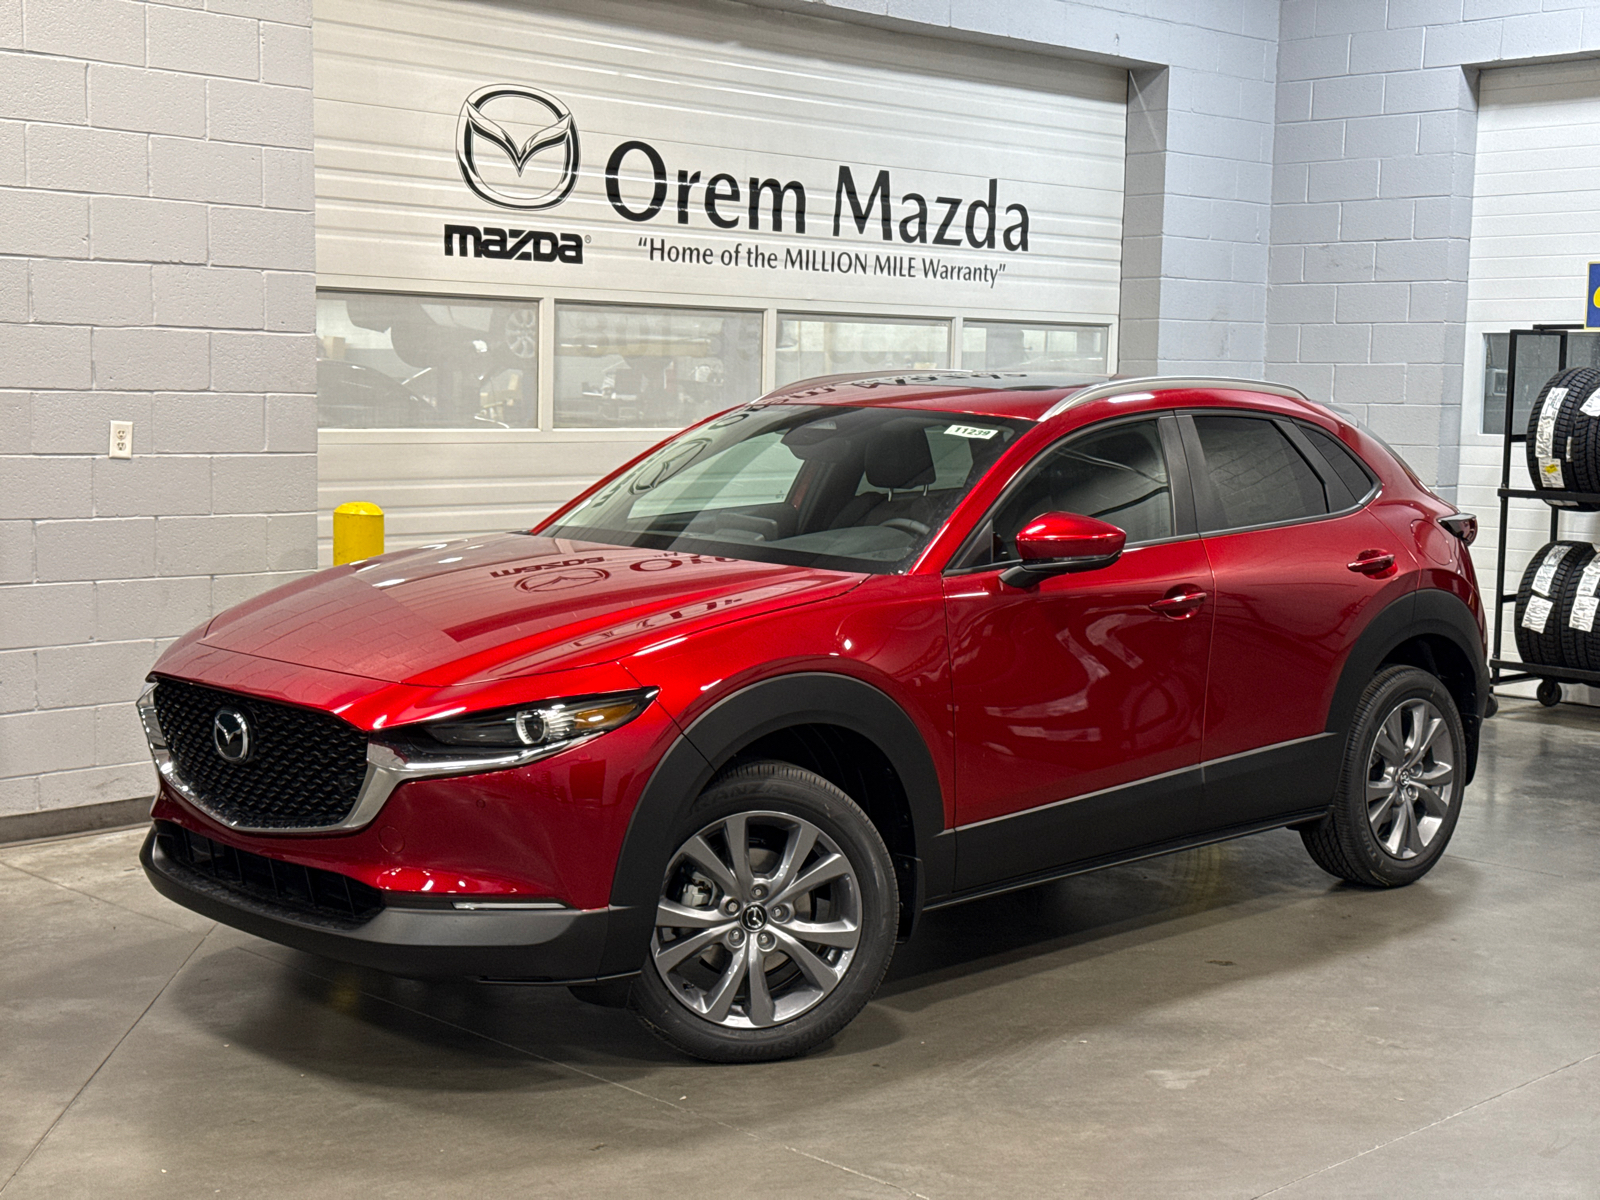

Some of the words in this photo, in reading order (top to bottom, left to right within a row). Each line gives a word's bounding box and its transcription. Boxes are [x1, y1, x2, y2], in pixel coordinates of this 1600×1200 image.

[605, 140, 806, 234] Orem
[832, 165, 1030, 252] Mazda
[720, 243, 742, 267] of
[747, 244, 778, 269] the
[784, 248, 867, 275] MILLION
[874, 254, 916, 278] MILE
[955, 426, 991, 437] 11239
